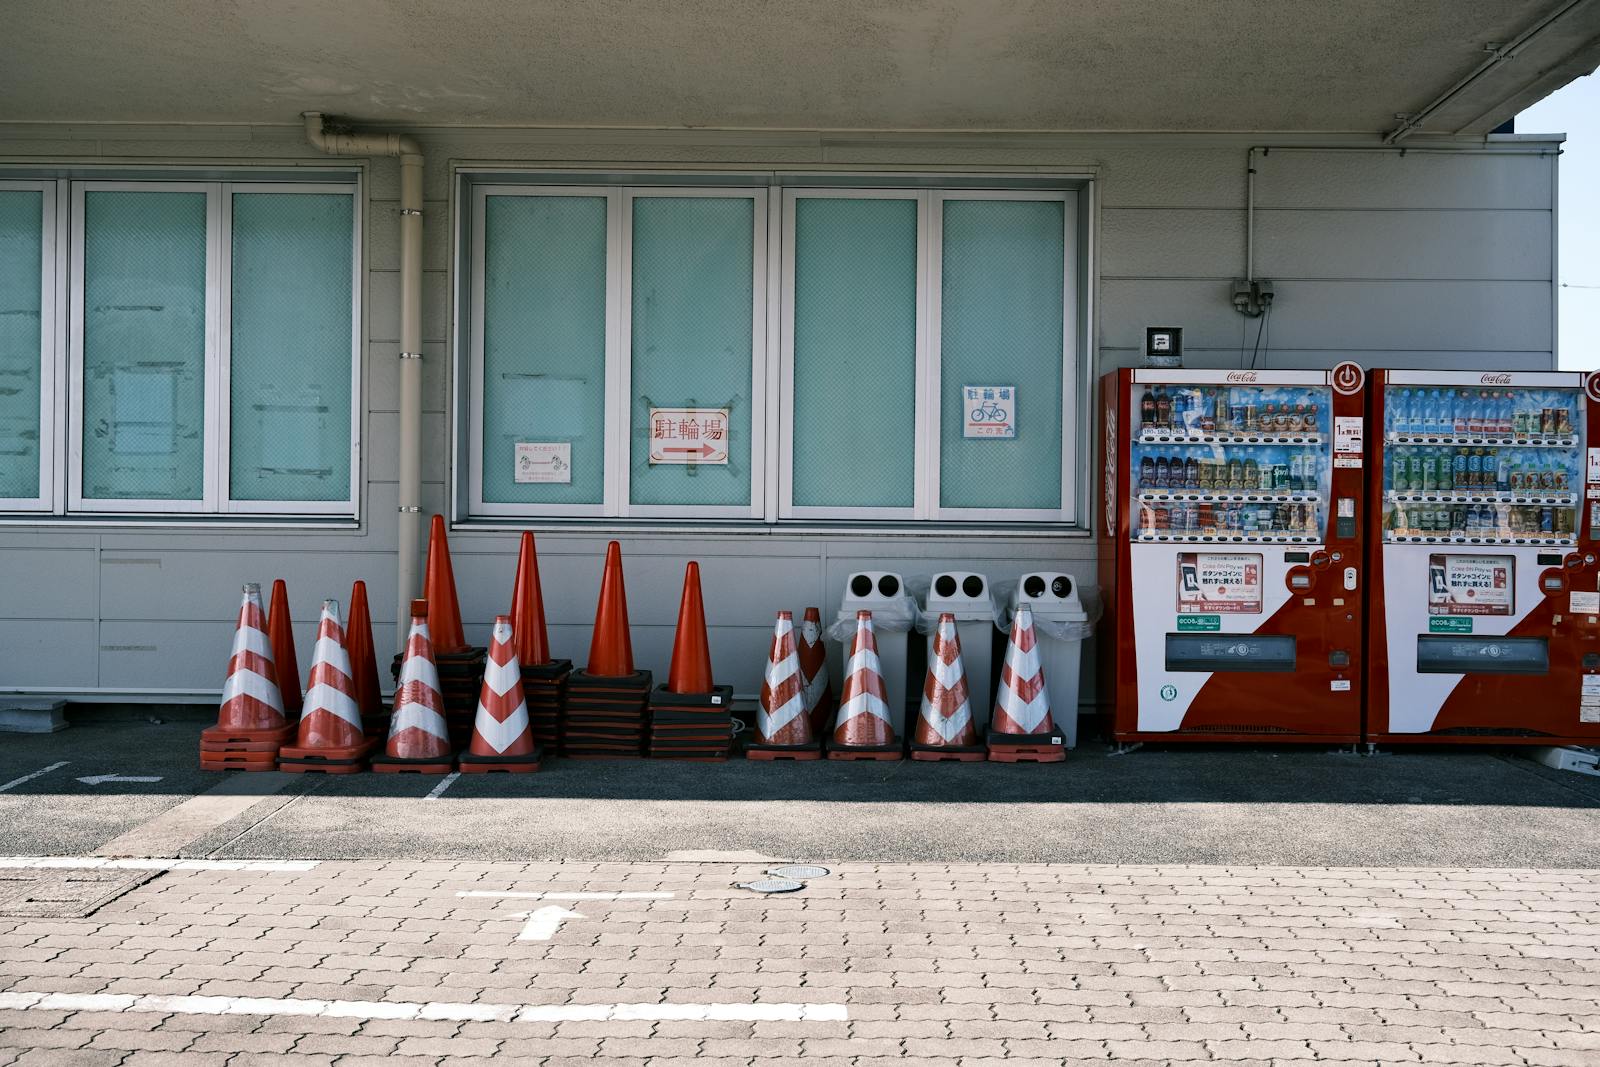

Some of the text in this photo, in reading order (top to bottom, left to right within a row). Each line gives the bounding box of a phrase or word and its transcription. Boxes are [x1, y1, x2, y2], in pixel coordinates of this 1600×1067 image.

[967, 388, 1010, 400] 駐輪場
[654, 418, 724, 441] 駐輪場
